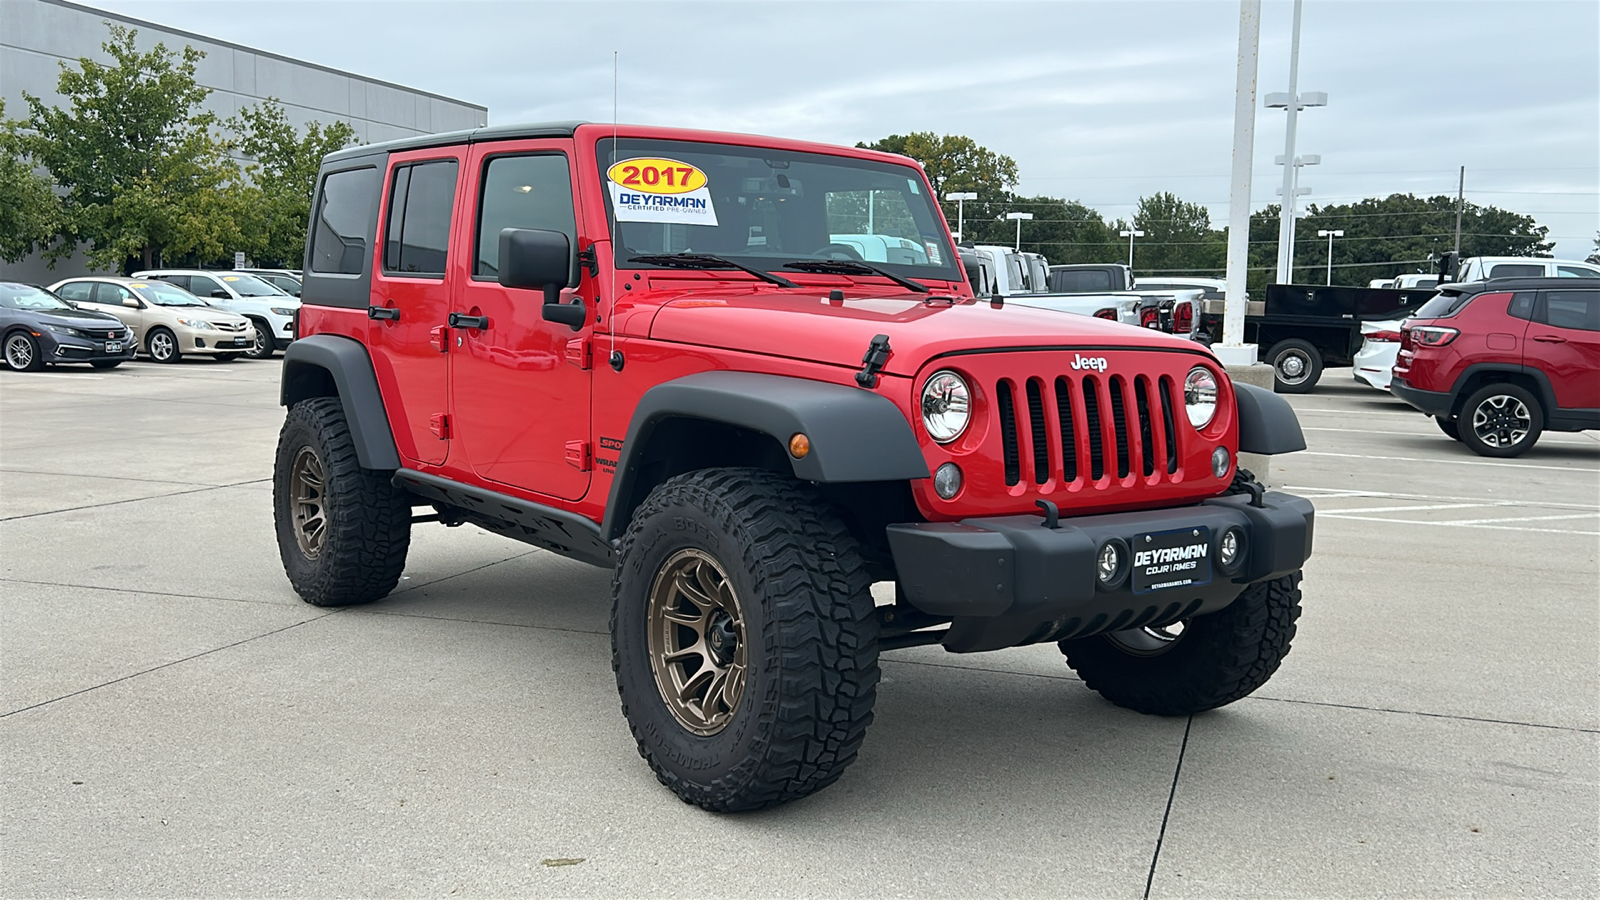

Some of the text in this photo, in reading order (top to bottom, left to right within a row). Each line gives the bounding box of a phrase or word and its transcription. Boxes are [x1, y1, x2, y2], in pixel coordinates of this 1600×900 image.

[622, 166, 694, 187] 2017
[619, 193, 706, 208] DEYARMAN
[627, 204, 707, 214] CERTIFIED PRE-OWNED
[1070, 353, 1108, 373] Jeep
[602, 439, 623, 449] SPO
[1133, 543, 1208, 568] DEYARMAN
